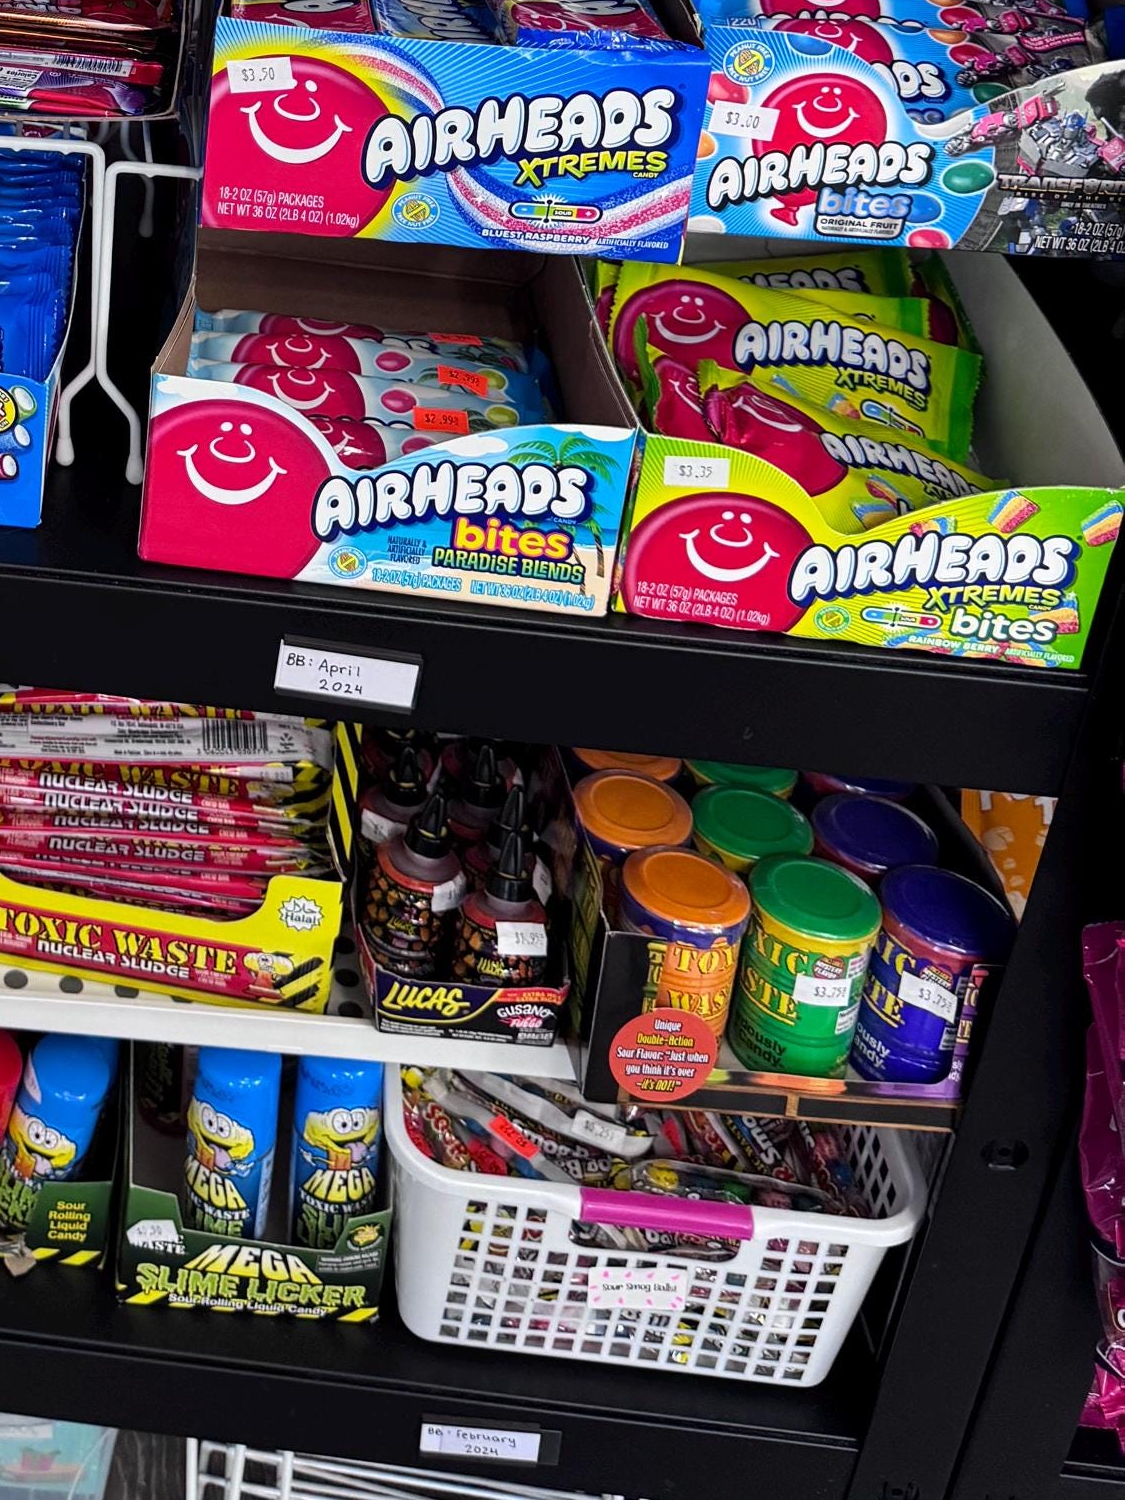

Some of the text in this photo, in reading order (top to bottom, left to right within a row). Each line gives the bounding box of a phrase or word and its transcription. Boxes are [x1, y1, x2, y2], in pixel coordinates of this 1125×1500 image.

[242, 66, 275, 83] $3.50
[365, 87, 675, 184] AIRHEADS
[517, 149, 667, 187] XTREMES
[709, 142, 934, 207] AIRHEADS
[219, 187, 324, 208] 18-2 OZ (57g) PACKAGES
[819, 188, 911, 220] bites
[820, 219, 899, 233] ORIGINAL FRUIT
[482, 229, 589, 244] BLUEST RASPBERRY
[315, 465, 586, 541] AIRHEADS
[454, 517, 570, 558] bites
[521, 559, 584, 583] BLENDS
[792, 534, 1074, 602] AIRHEADS
[925, 584, 1060, 611] XTREMES
[950, 609, 1057, 642] bites
[908, 635, 1000, 654] RAINBOW BERRY
[318, 658, 360, 679] April
[319, 678, 363, 696] 2024
[283, 909, 322, 927] Halal
[37, 939, 189, 980] NUCLEAR SLUDGE
[112, 931, 238, 975] WASTE
[381, 981, 470, 1017] LUCAS
[654, 1019, 682, 1032] Unique
[636, 1034, 694, 1048] Double-Action
[617, 1047, 635, 1059] Sour
[636, 1049, 663, 1061] Flavor:
[686, 1053, 709, 1064] when
[626, 1064, 695, 1078] you think it's over
[56, 1200, 84, 1212] Sour
[47, 1210, 91, 1223] Rolling
[49, 1220, 87, 1233] Liquid
[47, 1230, 86, 1243] Candy
[184, 1244, 323, 1285] MEGA
[136, 1263, 367, 1308] SLIME LICKER
[602, 1282, 624, 1292] Sour
[626, 1282, 651, 1293] Smog
[456, 1429, 517, 1448] February
[465, 1444, 499, 1456] 2024
